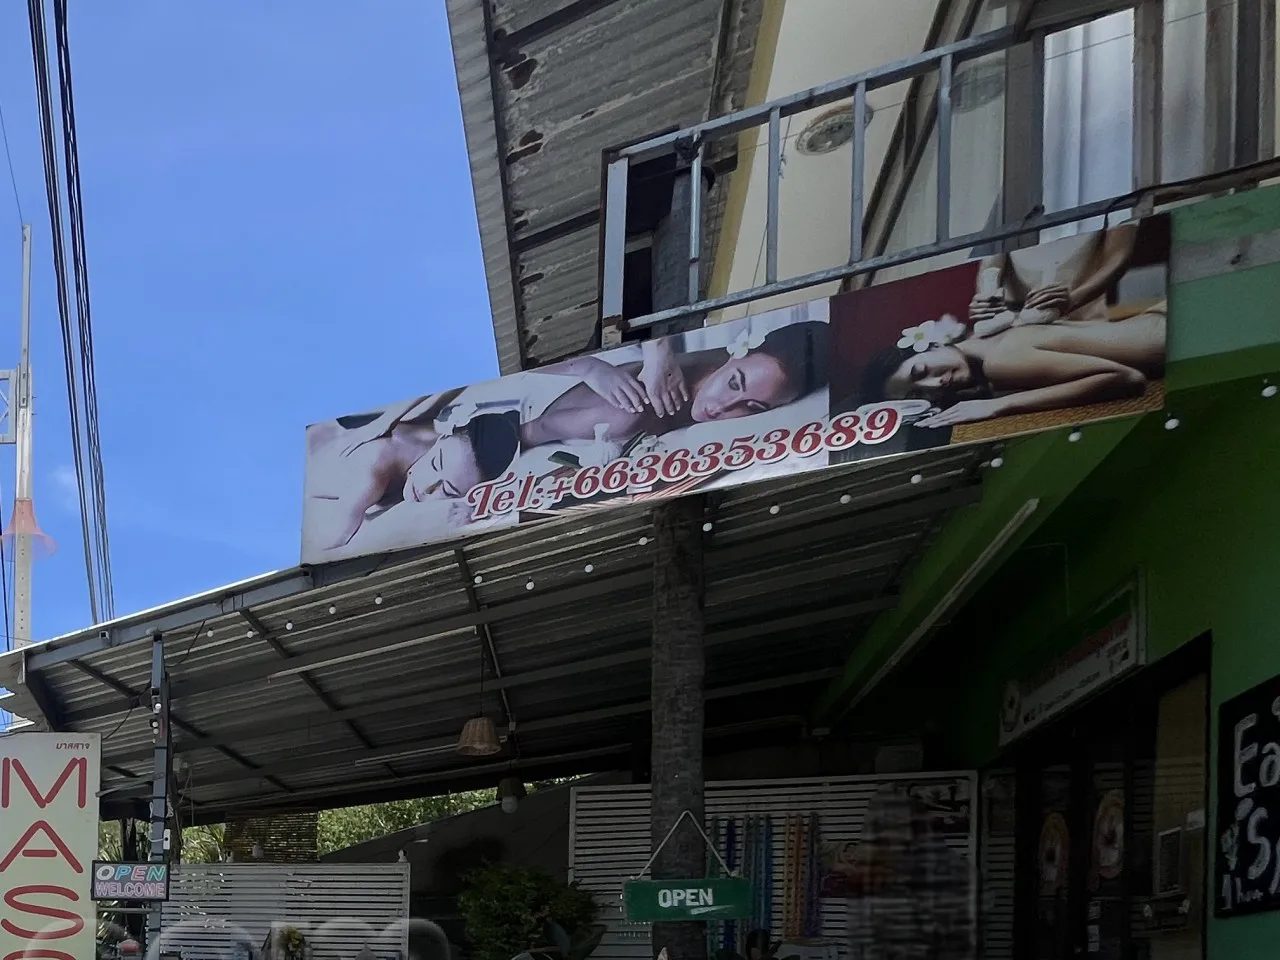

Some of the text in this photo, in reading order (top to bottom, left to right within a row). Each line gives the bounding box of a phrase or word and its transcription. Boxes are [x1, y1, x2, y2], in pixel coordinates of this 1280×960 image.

[96, 865, 166, 881] OPEN
[95, 882, 164, 897] WELCOME
[658, 888, 714, 908] OPEN
